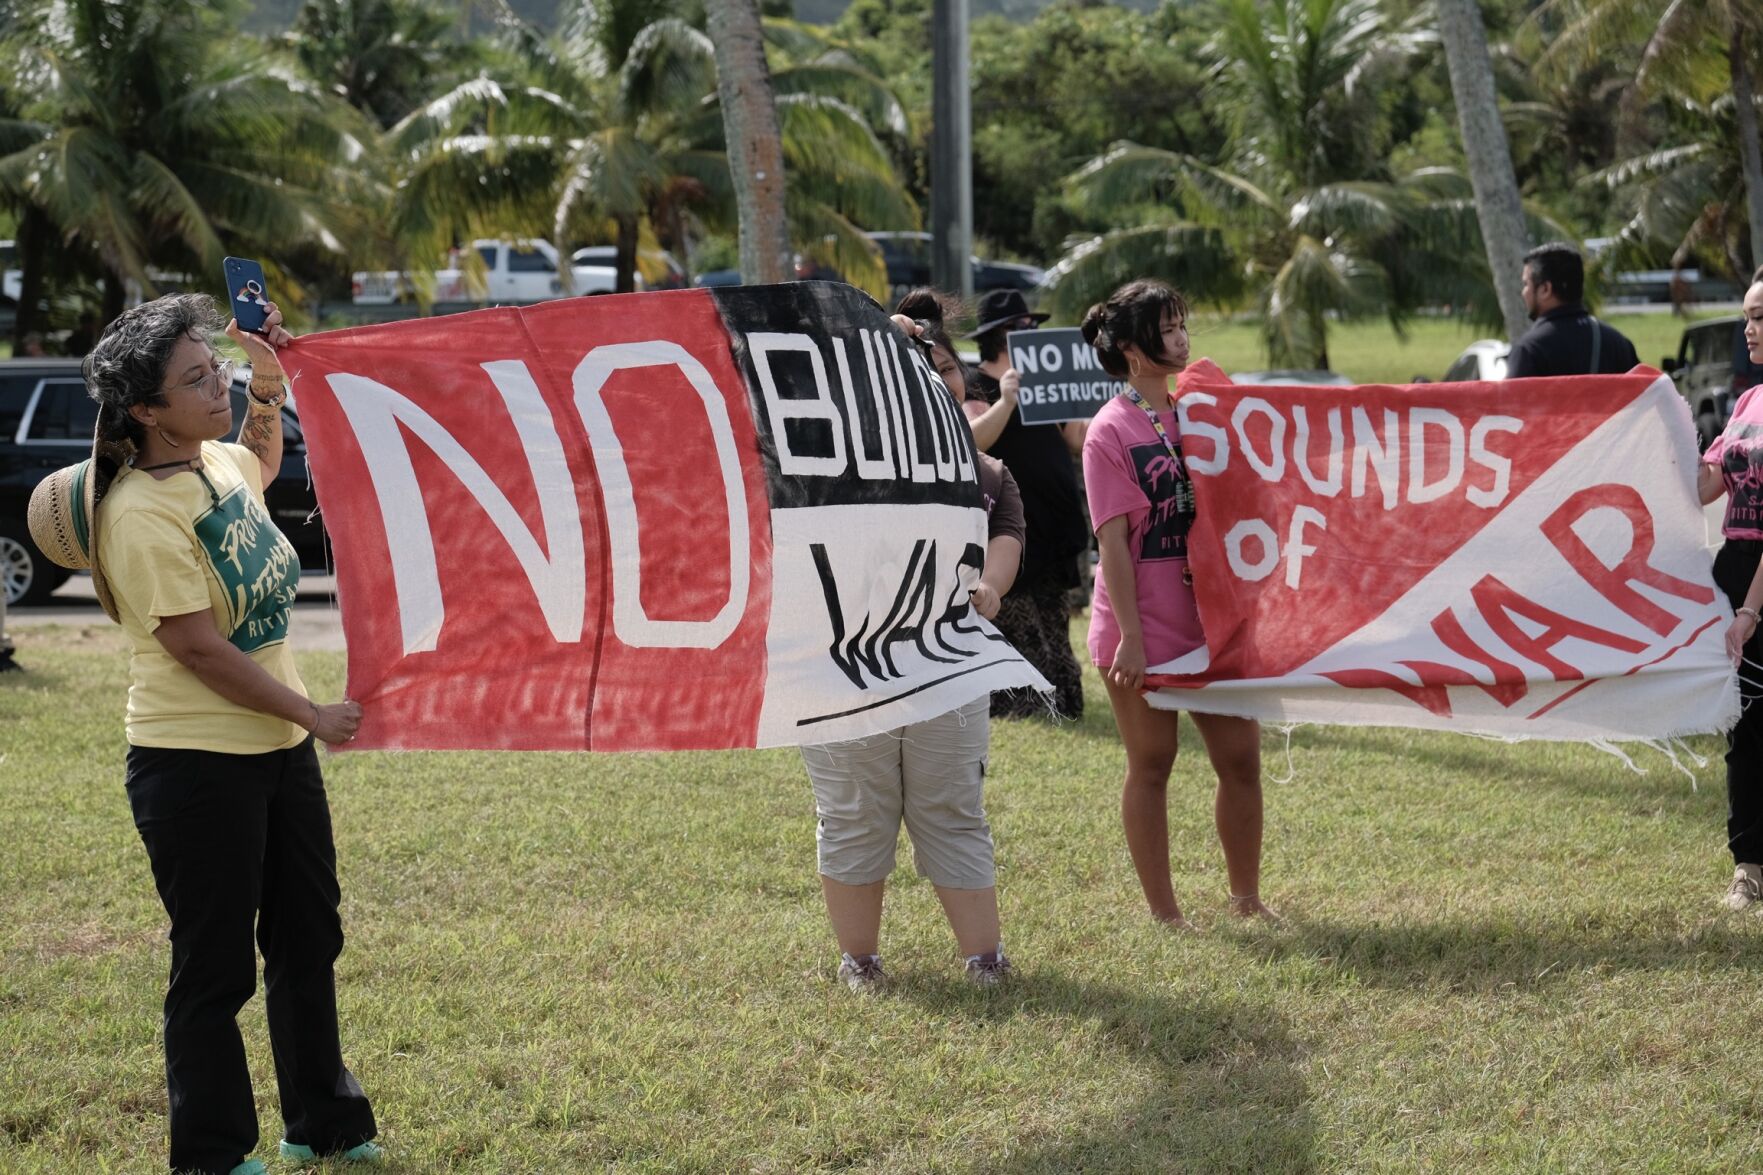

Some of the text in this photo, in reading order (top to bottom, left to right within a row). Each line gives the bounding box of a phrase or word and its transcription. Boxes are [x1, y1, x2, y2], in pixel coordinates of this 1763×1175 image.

[746, 328, 978, 485] BUILDU
[1013, 344, 1063, 374] NO
[325, 340, 750, 657] NO
[1177, 391, 1524, 510] SOUNDS
[1313, 483, 1716, 718] WAR
